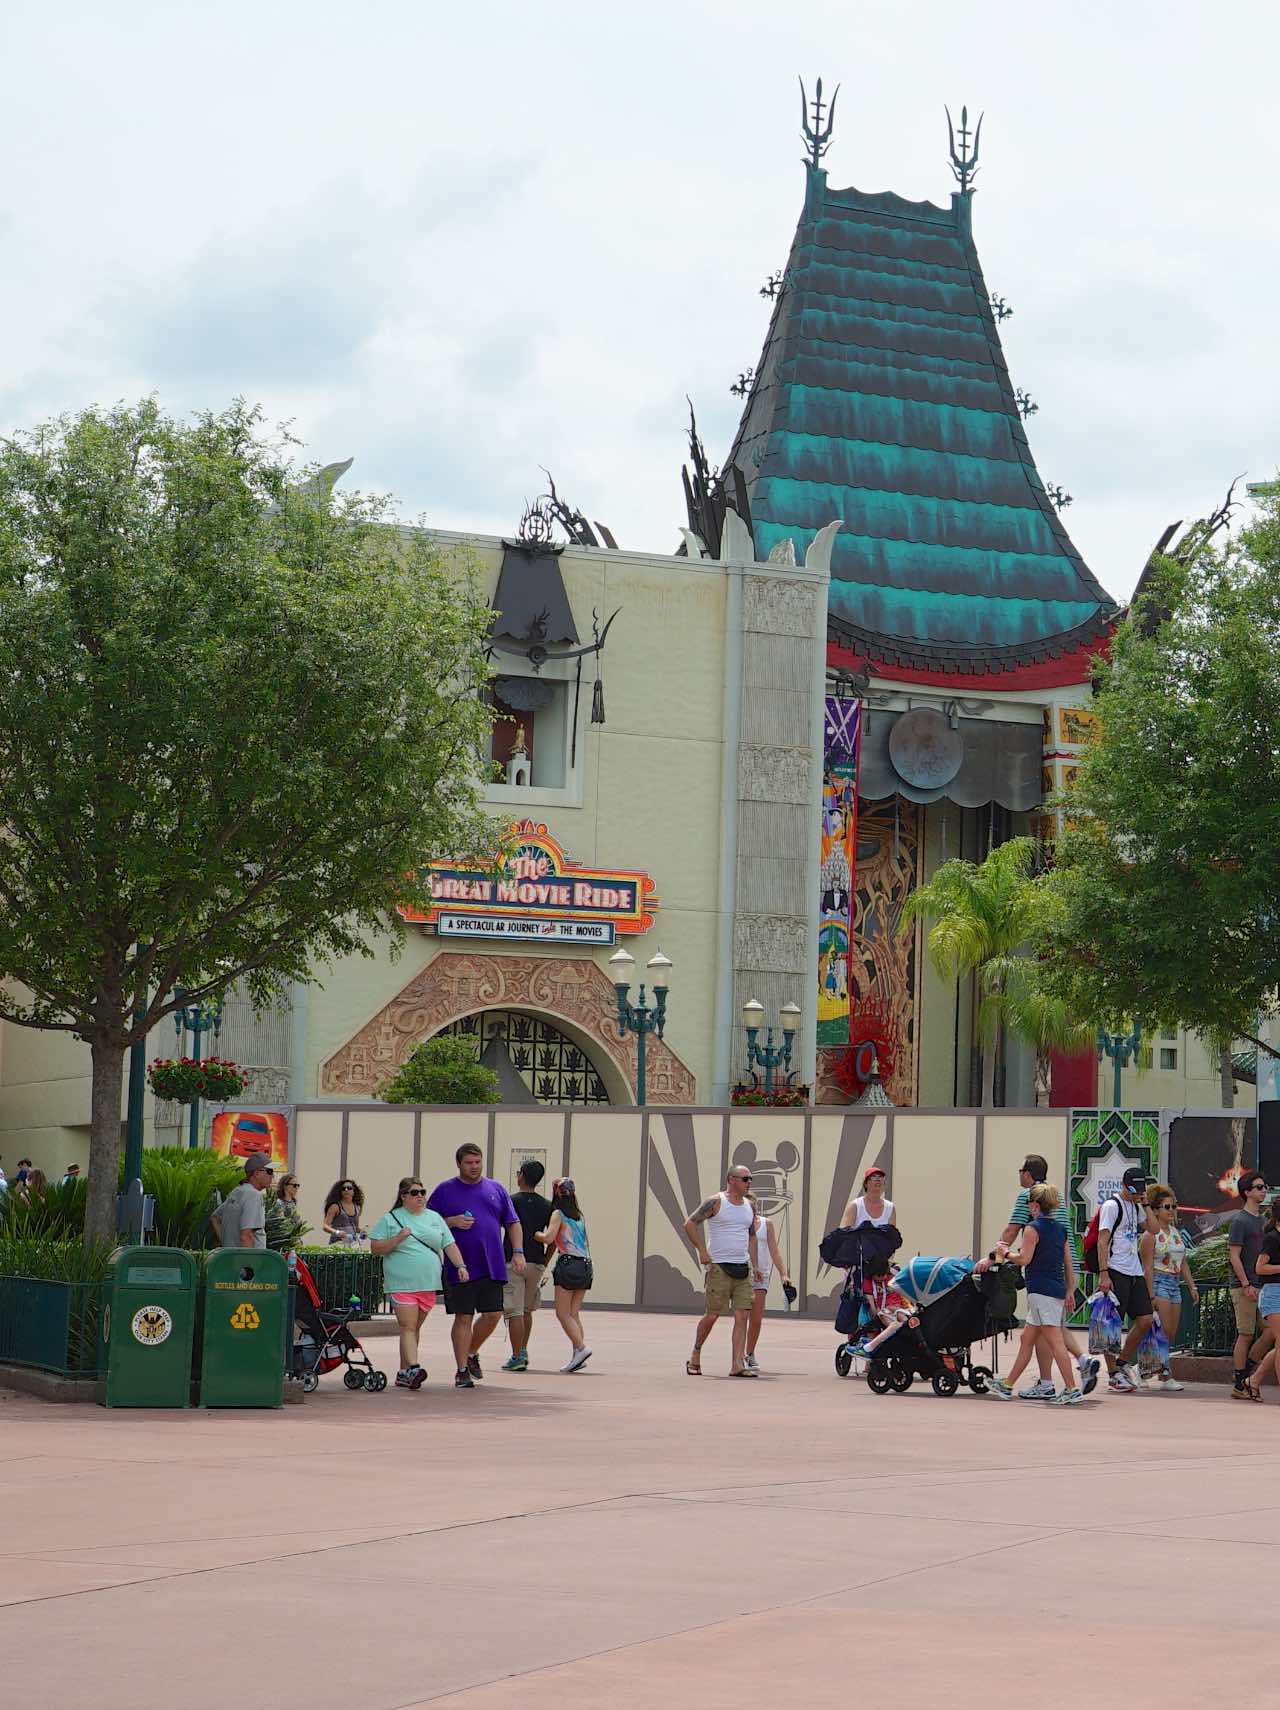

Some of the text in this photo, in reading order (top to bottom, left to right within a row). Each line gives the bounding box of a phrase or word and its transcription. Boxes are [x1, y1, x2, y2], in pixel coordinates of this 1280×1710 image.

[508, 855, 549, 880] The
[497, 880, 571, 905] MOVIE
[573, 883, 632, 909] RIDE
[448, 920, 454, 930] A
[456, 920, 505, 932] SPECTACULAR
[507, 922, 540, 934] JOURNEY
[560, 925, 574, 935] THE
[576, 926, 603, 937] MOVIES
[1098, 1180, 1121, 1190] DISN
